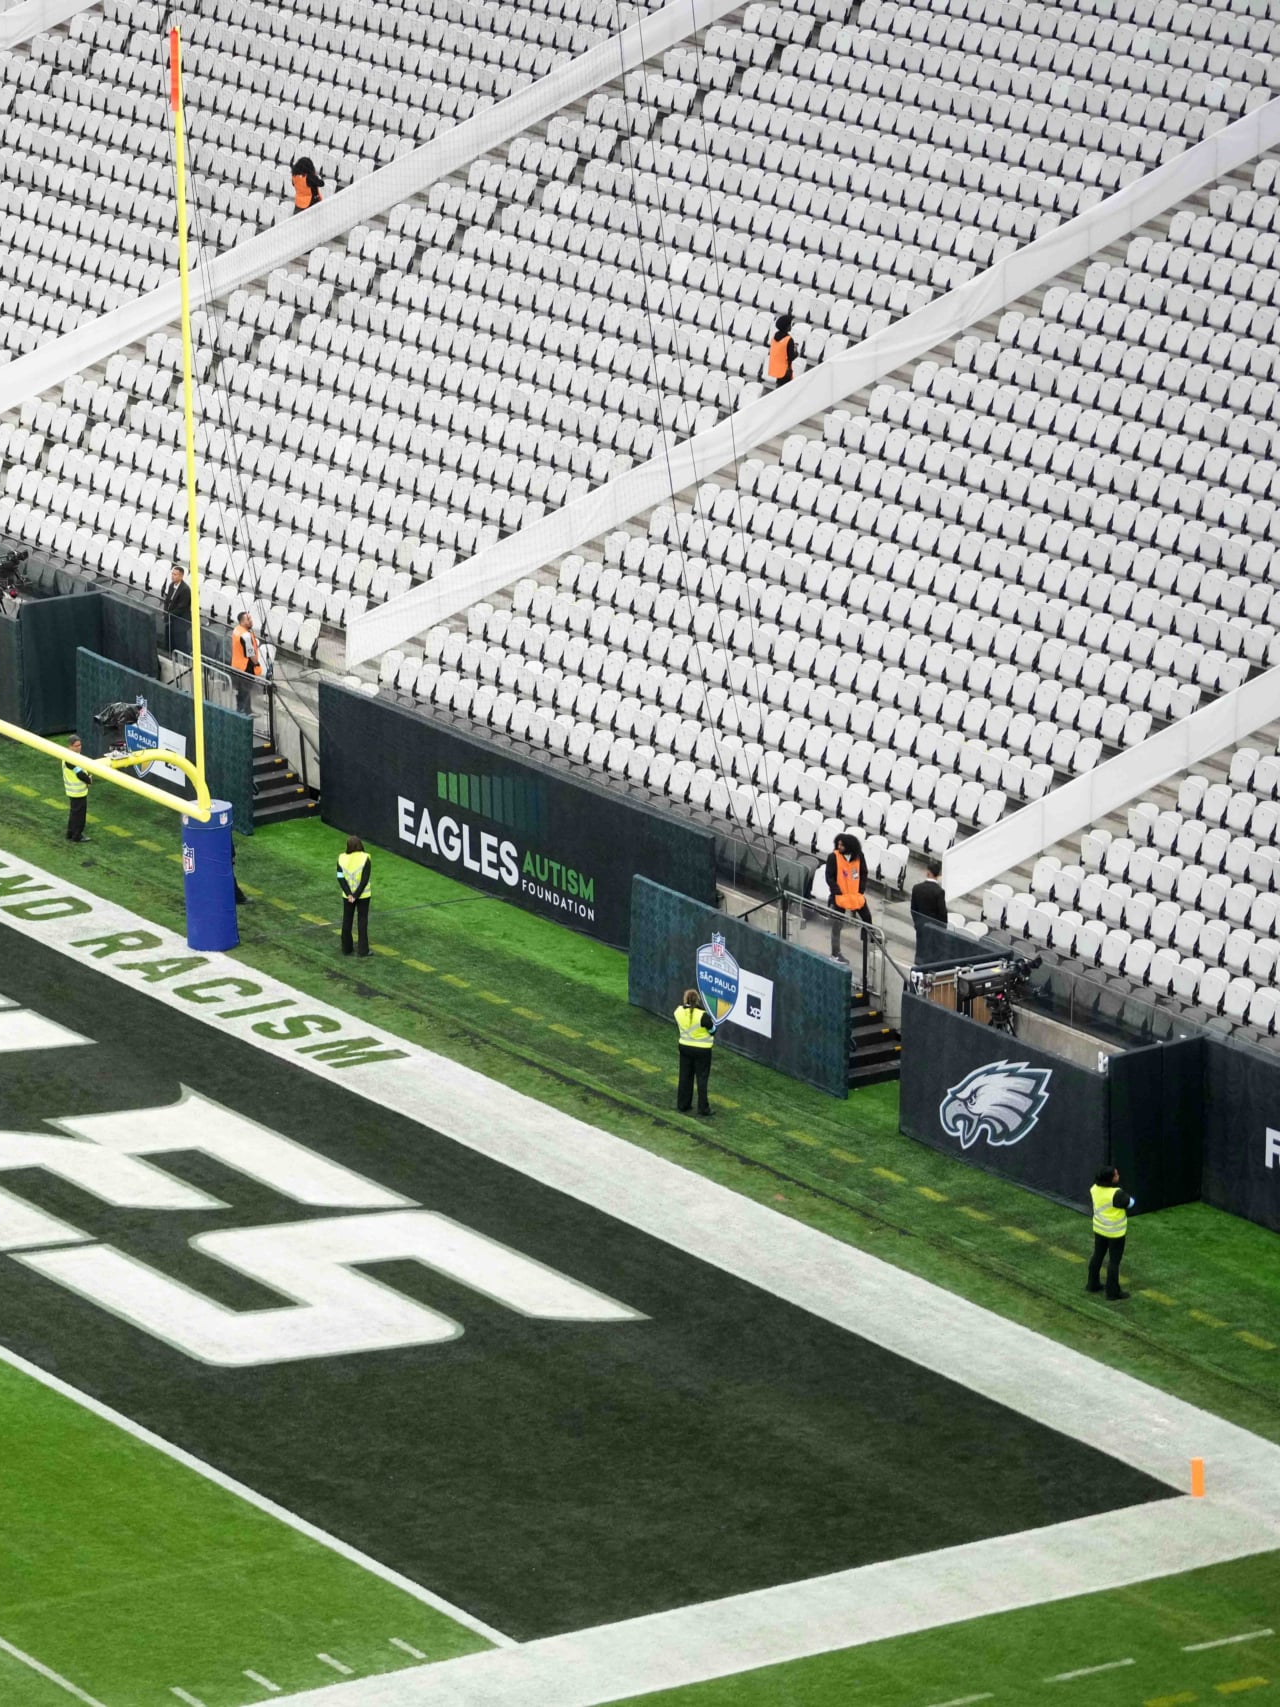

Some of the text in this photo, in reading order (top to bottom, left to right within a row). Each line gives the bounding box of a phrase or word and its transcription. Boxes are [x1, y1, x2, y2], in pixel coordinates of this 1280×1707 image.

[138, 735, 157, 748] PAULO
[397, 795, 520, 887] EAGLES
[522, 850, 595, 902] AUTISM
[522, 879, 595, 921] FOUNDATION
[713, 943, 724, 956] NFL
[69, 928, 412, 1070] RACISM
[699, 970, 713, 983] SÃO
[714, 977, 737, 993] PAULO
